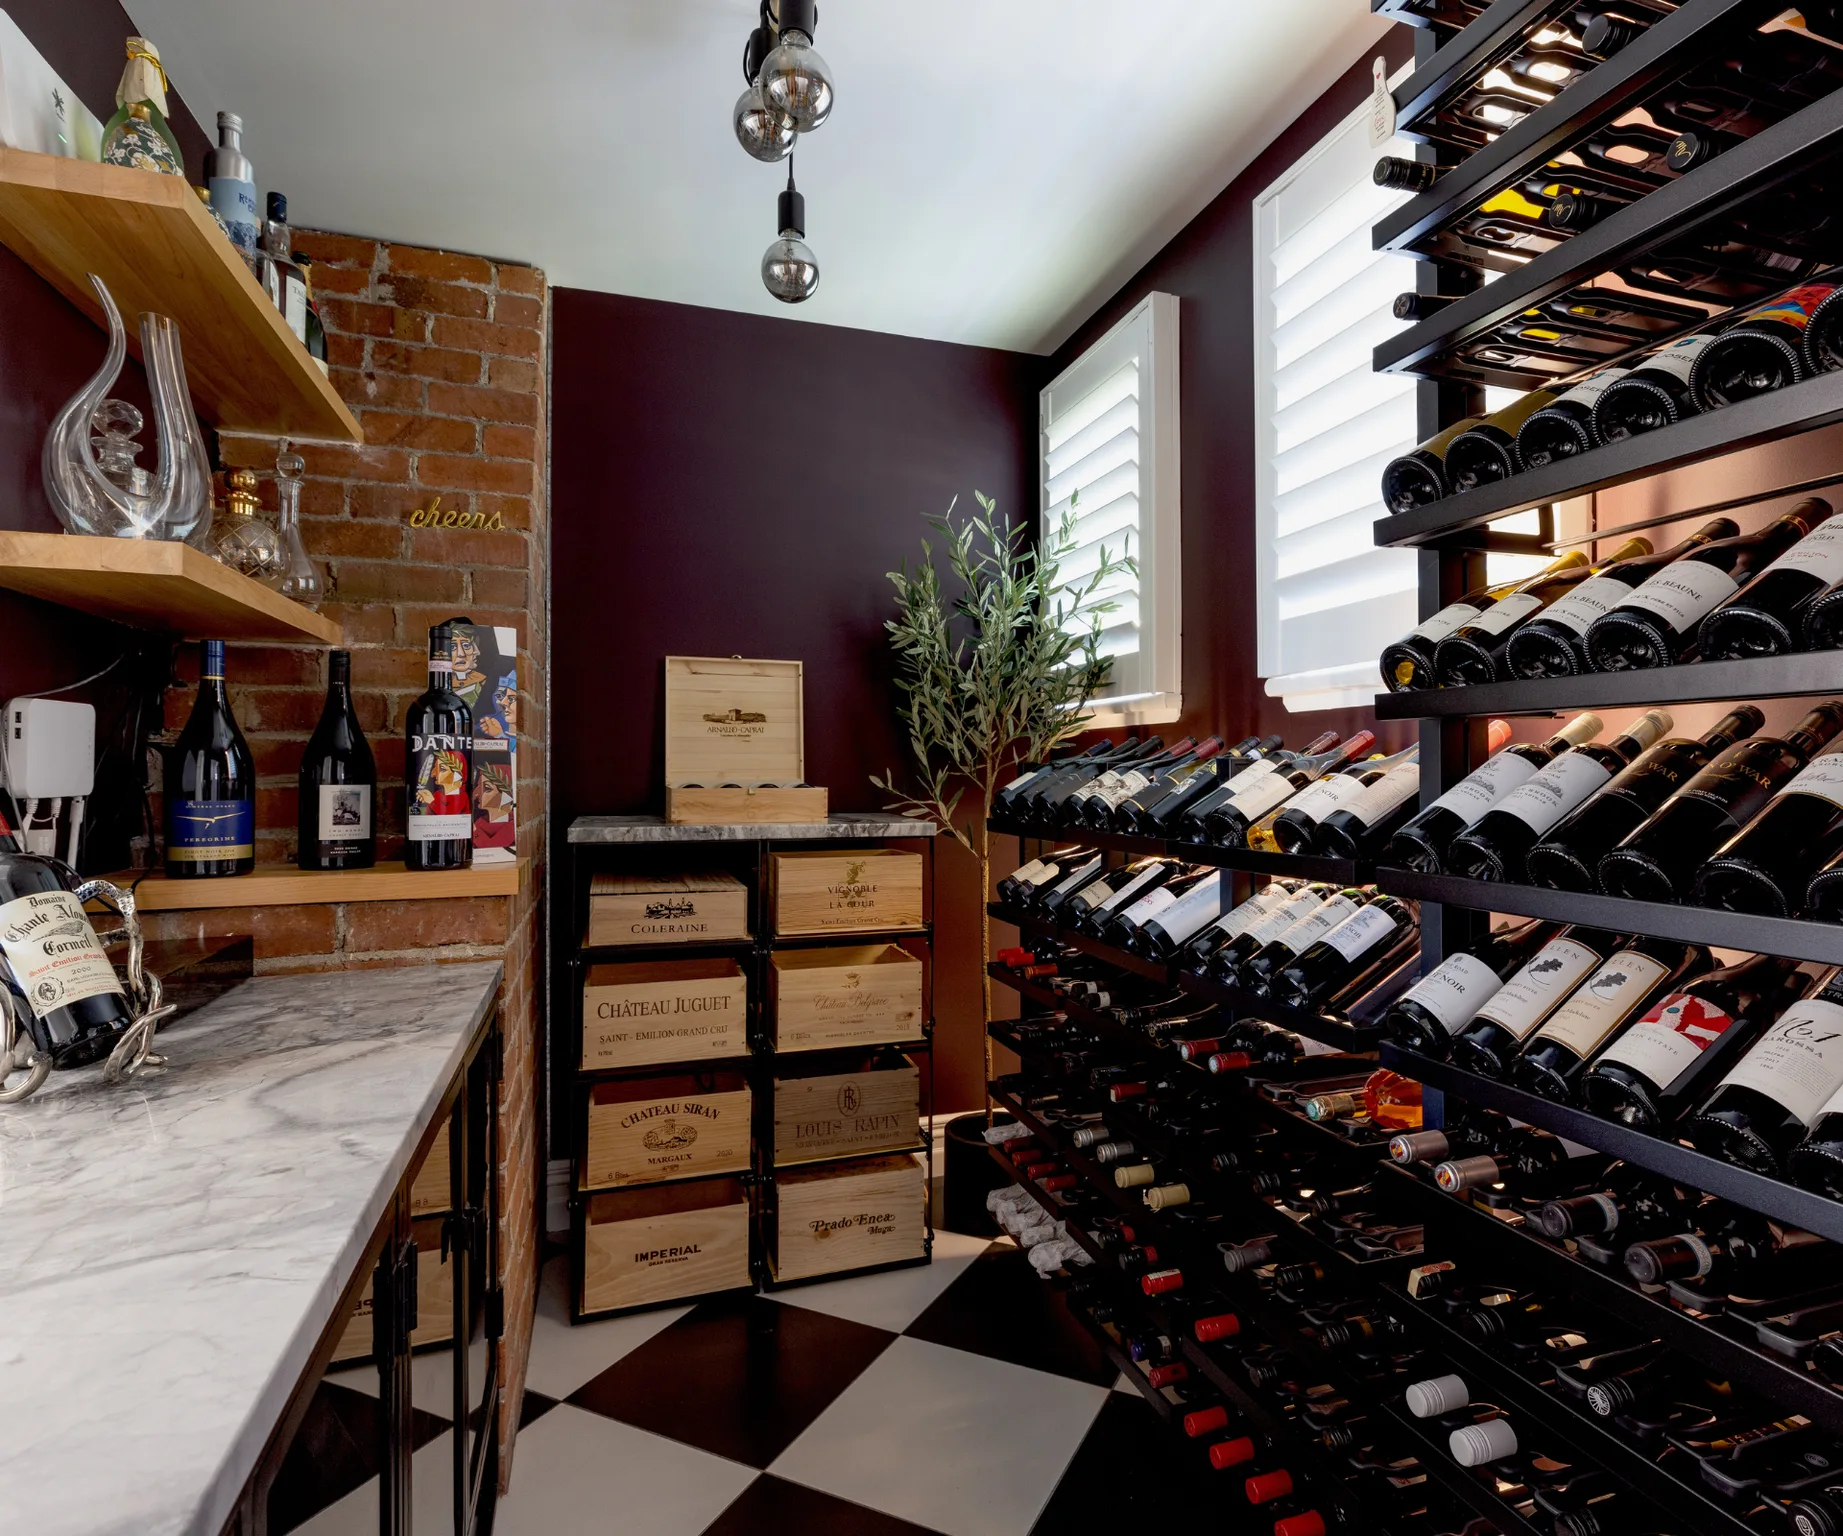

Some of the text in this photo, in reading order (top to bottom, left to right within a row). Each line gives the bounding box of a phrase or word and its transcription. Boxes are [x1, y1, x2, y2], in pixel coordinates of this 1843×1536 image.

[409, 496, 505, 531] cheers
[411, 734, 473, 753] DANTE
[1648, 761, 1680, 783] WAR
[1739, 764, 1772, 790] WAR
[827, 884, 878, 894] VIGNOBLE
[630, 922, 709, 934] COLERAINE
[1440, 974, 1467, 995] NOIR
[597, 996, 731, 1019] CHÂTEAU JUGUET
[599, 1033, 628, 1044] SAINT
[635, 1029, 675, 1041] EMILION
[676, 1026, 708, 1037] GRAND
[709, 1025, 728, 1034] CRU
[620, 1103, 721, 1129] CHATEAU SIRAN
[796, 1114, 900, 1139] LOUIS RAPIN
[648, 1153, 692, 1165] MARGAUX
[808, 1212, 896, 1233] Prado Enea
[635, 1244, 702, 1263] IMPERIAL
